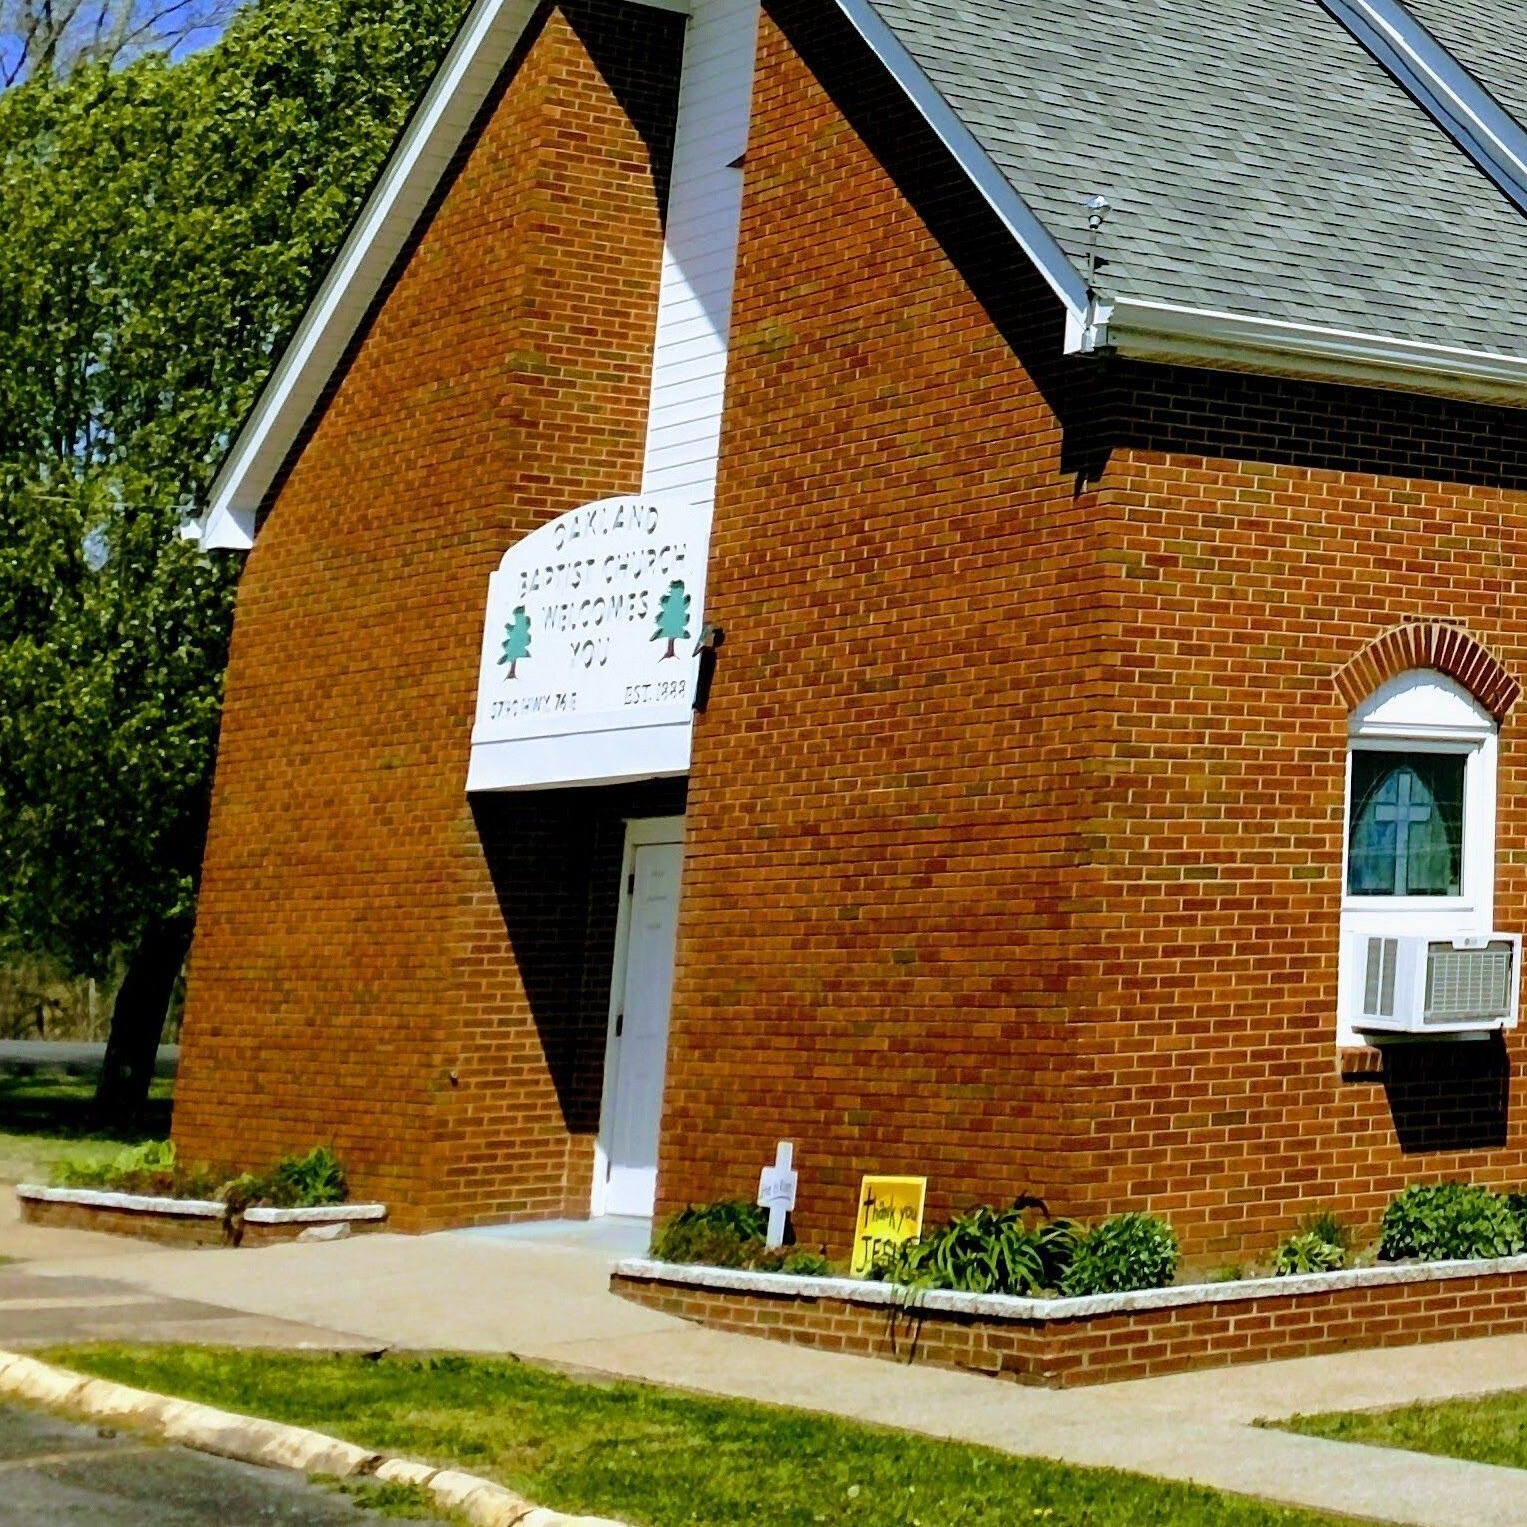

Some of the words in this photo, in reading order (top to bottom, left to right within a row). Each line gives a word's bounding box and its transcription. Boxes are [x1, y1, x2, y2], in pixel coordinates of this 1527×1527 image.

[554, 504, 659, 551] OAKLAND
[518, 558, 596, 599] BAPTIST
[603, 543, 687, 585] CHURCH
[541, 589, 649, 633] WELCOMES
[570, 636, 611, 668] YOU
